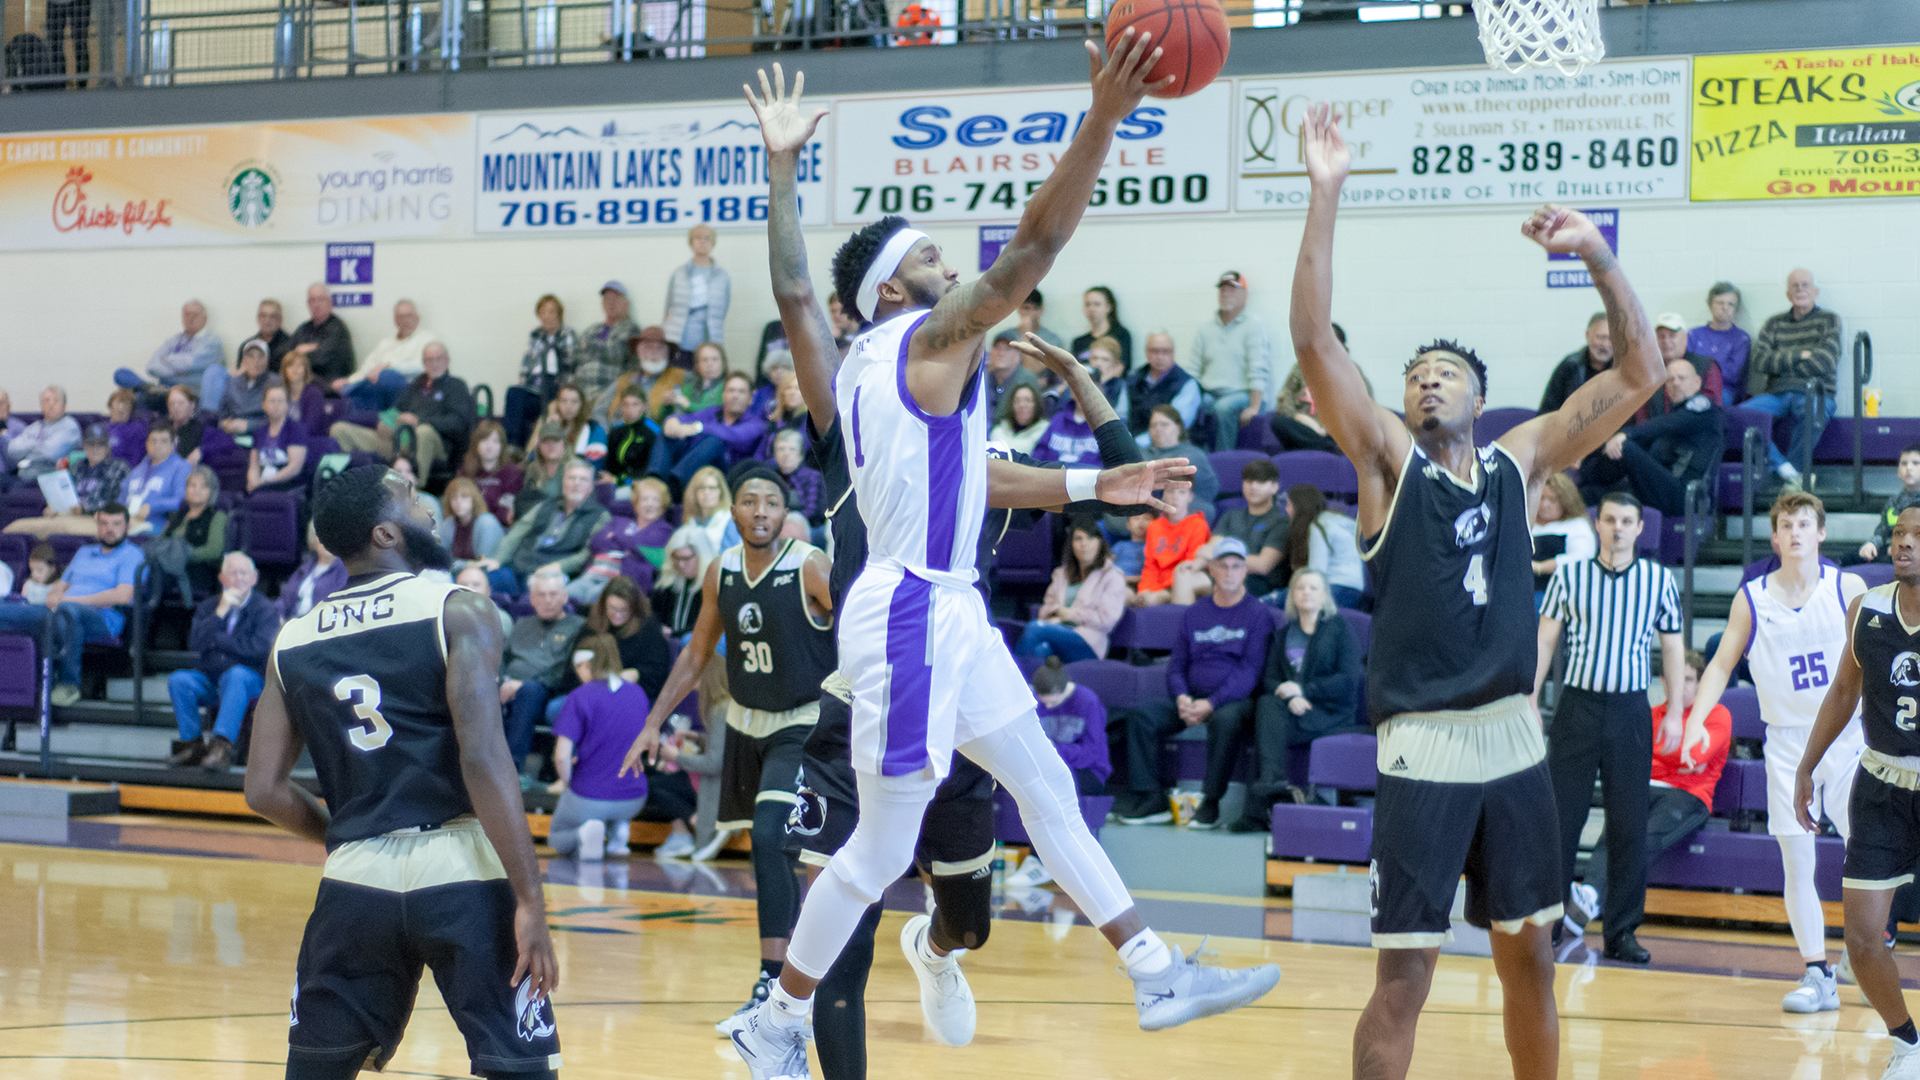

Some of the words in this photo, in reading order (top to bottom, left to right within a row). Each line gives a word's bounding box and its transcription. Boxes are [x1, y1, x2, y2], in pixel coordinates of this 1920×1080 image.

[1852, 54, 1875, 67] of
[1411, 79, 1448, 96] OPEN
[1454, 79, 1481, 95] FOR
[1487, 76, 1527, 93] DINNER
[1422, 91, 1671, 114] www.thecopperdoor.com
[1698, 73, 1867, 107] STEAKS
[892, 105, 1167, 149] Seas
[1282, 94, 1394, 137] Cpper
[1415, 122, 1424, 138] 2
[1433, 120, 1504, 138] SULLIVAN
[1654, 112, 1676, 128] NC
[7, 141, 56, 162] CAMPUS
[61, 139, 110, 160] CUISINE
[1694, 120, 1789, 162] PIZZA
[1812, 125, 1906, 143] Italian
[482, 152, 601, 192] MOUNTAIN
[612, 148, 682, 188] LAKES
[694, 142, 822, 187] MORTGE
[1412, 136, 1678, 175] 828-389-8460
[317, 170, 386, 193] young
[392, 164, 453, 185] harris
[1341, 187, 1452, 202] SUPPORTER
[1464, 185, 1494, 200] OF
[1767, 180, 1816, 195] Go
[318, 193, 451, 225] DINING
[329, 245, 371, 257] SECTION
[341, 259, 358, 282] K
[852, 384, 865, 468] 1
[1463, 554, 1488, 605] 4
[317, 593, 394, 633] UNC
[740, 641, 773, 674] 30
[1789, 651, 1829, 691] 25
[333, 673, 394, 751] 3
[1895, 696, 1917, 731] 2
